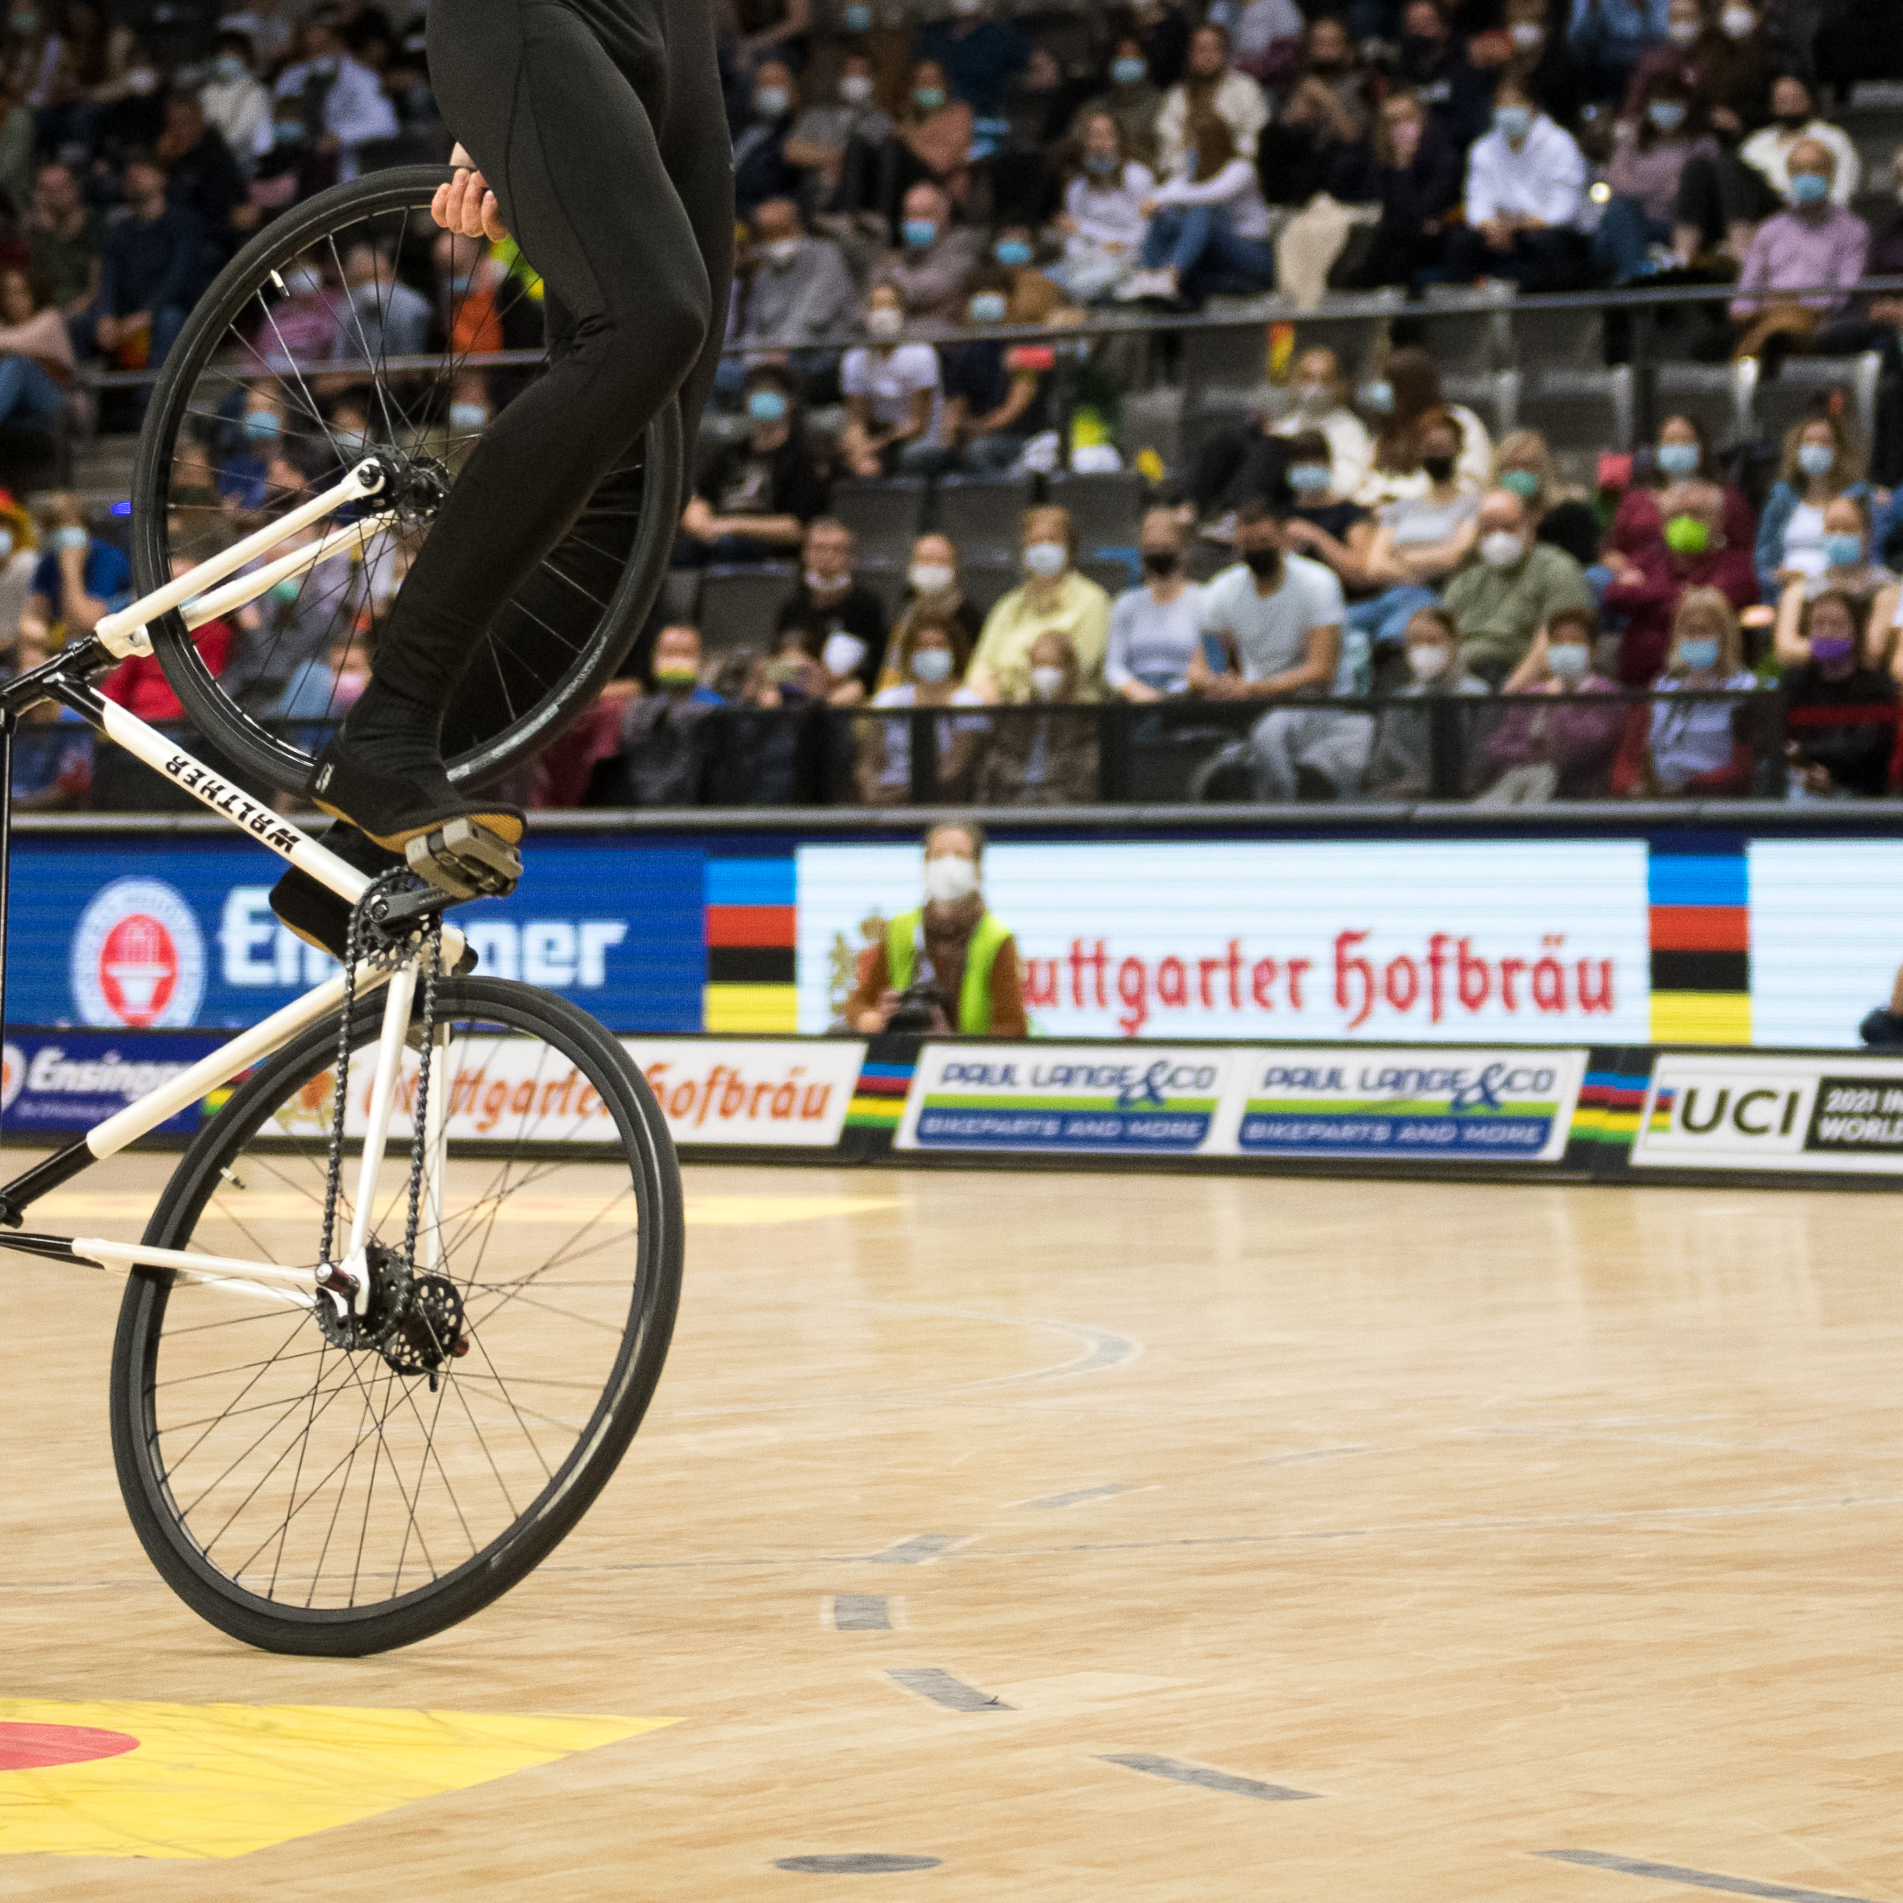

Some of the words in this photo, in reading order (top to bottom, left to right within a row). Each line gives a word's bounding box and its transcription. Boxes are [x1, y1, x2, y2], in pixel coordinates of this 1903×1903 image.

[165, 755, 301, 855] WALTHER
[919, 1115, 1061, 1137] BIKEPARTS
[1065, 1120, 1123, 1138] AND
[1127, 1120, 1202, 1140] MORE
[1678, 1087, 1802, 1136] UCI
[1825, 1089, 1877, 1113] 2021
[1247, 1122, 1392, 1142] BIKEPARTS
[1398, 1123, 1458, 1143] AND
[1460, 1124, 1543, 1144] MORE
